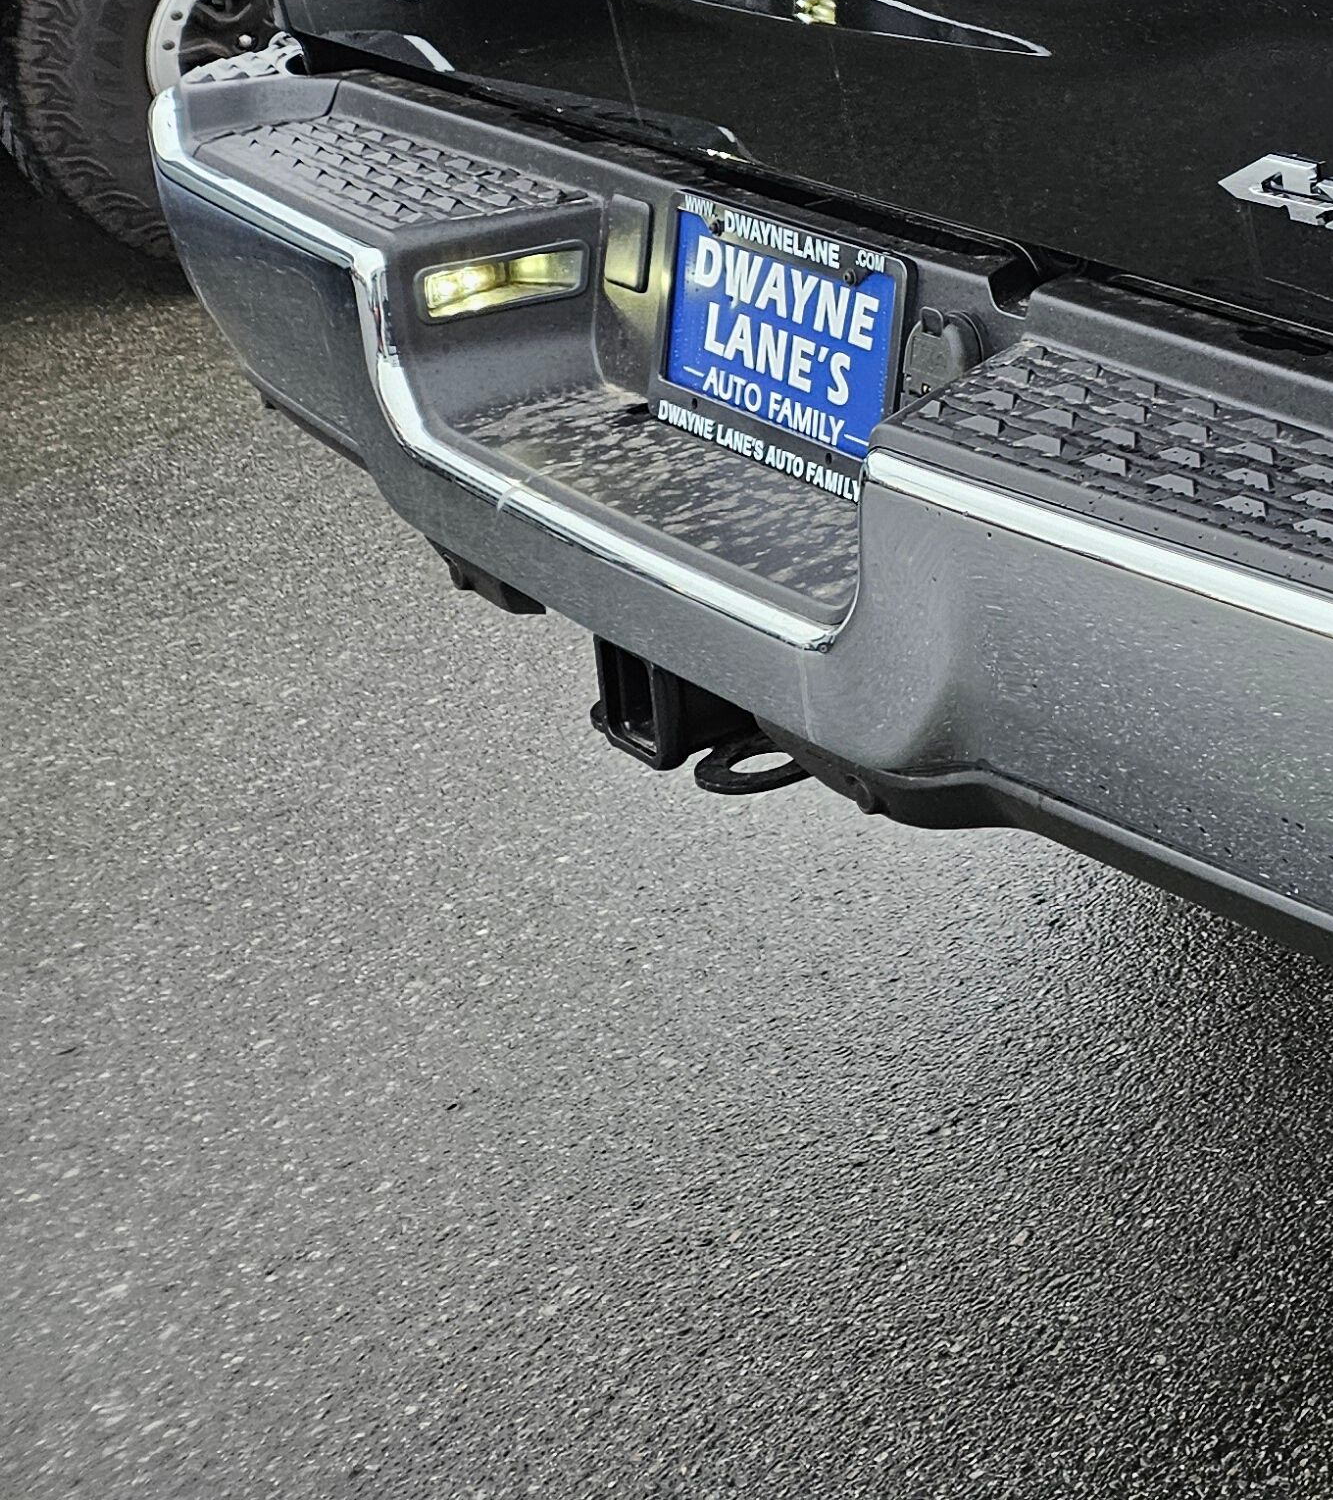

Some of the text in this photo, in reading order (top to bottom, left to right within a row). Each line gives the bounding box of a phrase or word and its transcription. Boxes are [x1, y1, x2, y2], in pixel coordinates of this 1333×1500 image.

[723, 210, 841, 270] DWAYNELANE
[694, 235, 880, 351] DWAYNE
[704, 301, 851, 405] LANE'S
[657, 400, 716, 440] DWAYNE
[716, 424, 764, 462] LANE'S
[765, 445, 804, 477] AUTO
[703, 366, 845, 446] AUTO FAMILY
